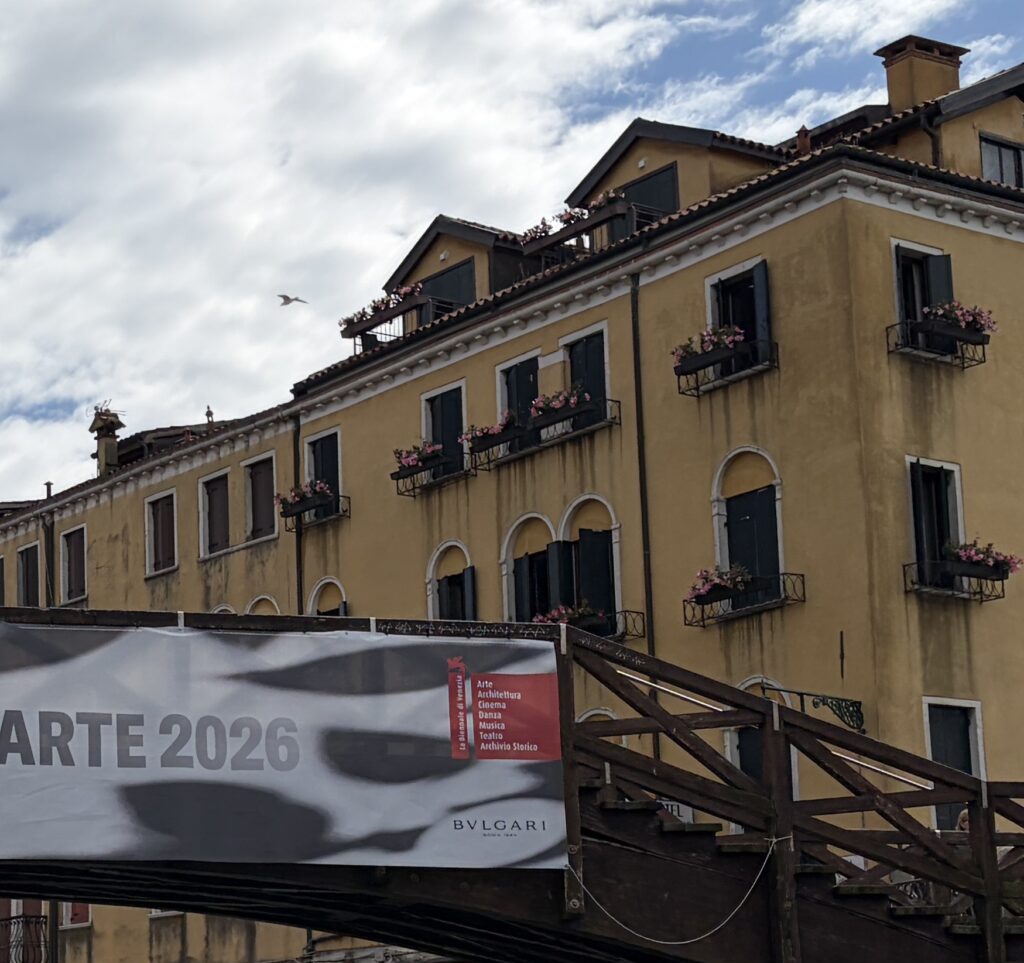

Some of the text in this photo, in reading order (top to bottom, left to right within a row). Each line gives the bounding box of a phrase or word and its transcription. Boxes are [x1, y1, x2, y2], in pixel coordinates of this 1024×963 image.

[477, 680, 493, 688] Arte
[477, 690, 522, 700] Architettura
[478, 700, 507, 709] Cinema
[478, 711, 502, 719] Danza
[457, 711, 465, 742] Biennale
[479, 721, 506, 729] Musica
[479, 731, 503, 740] Teatro
[158, 713, 301, 772] 2026
[480, 741, 538, 751] Archivio Storico
[453, 819, 546, 831] BVLGARI
